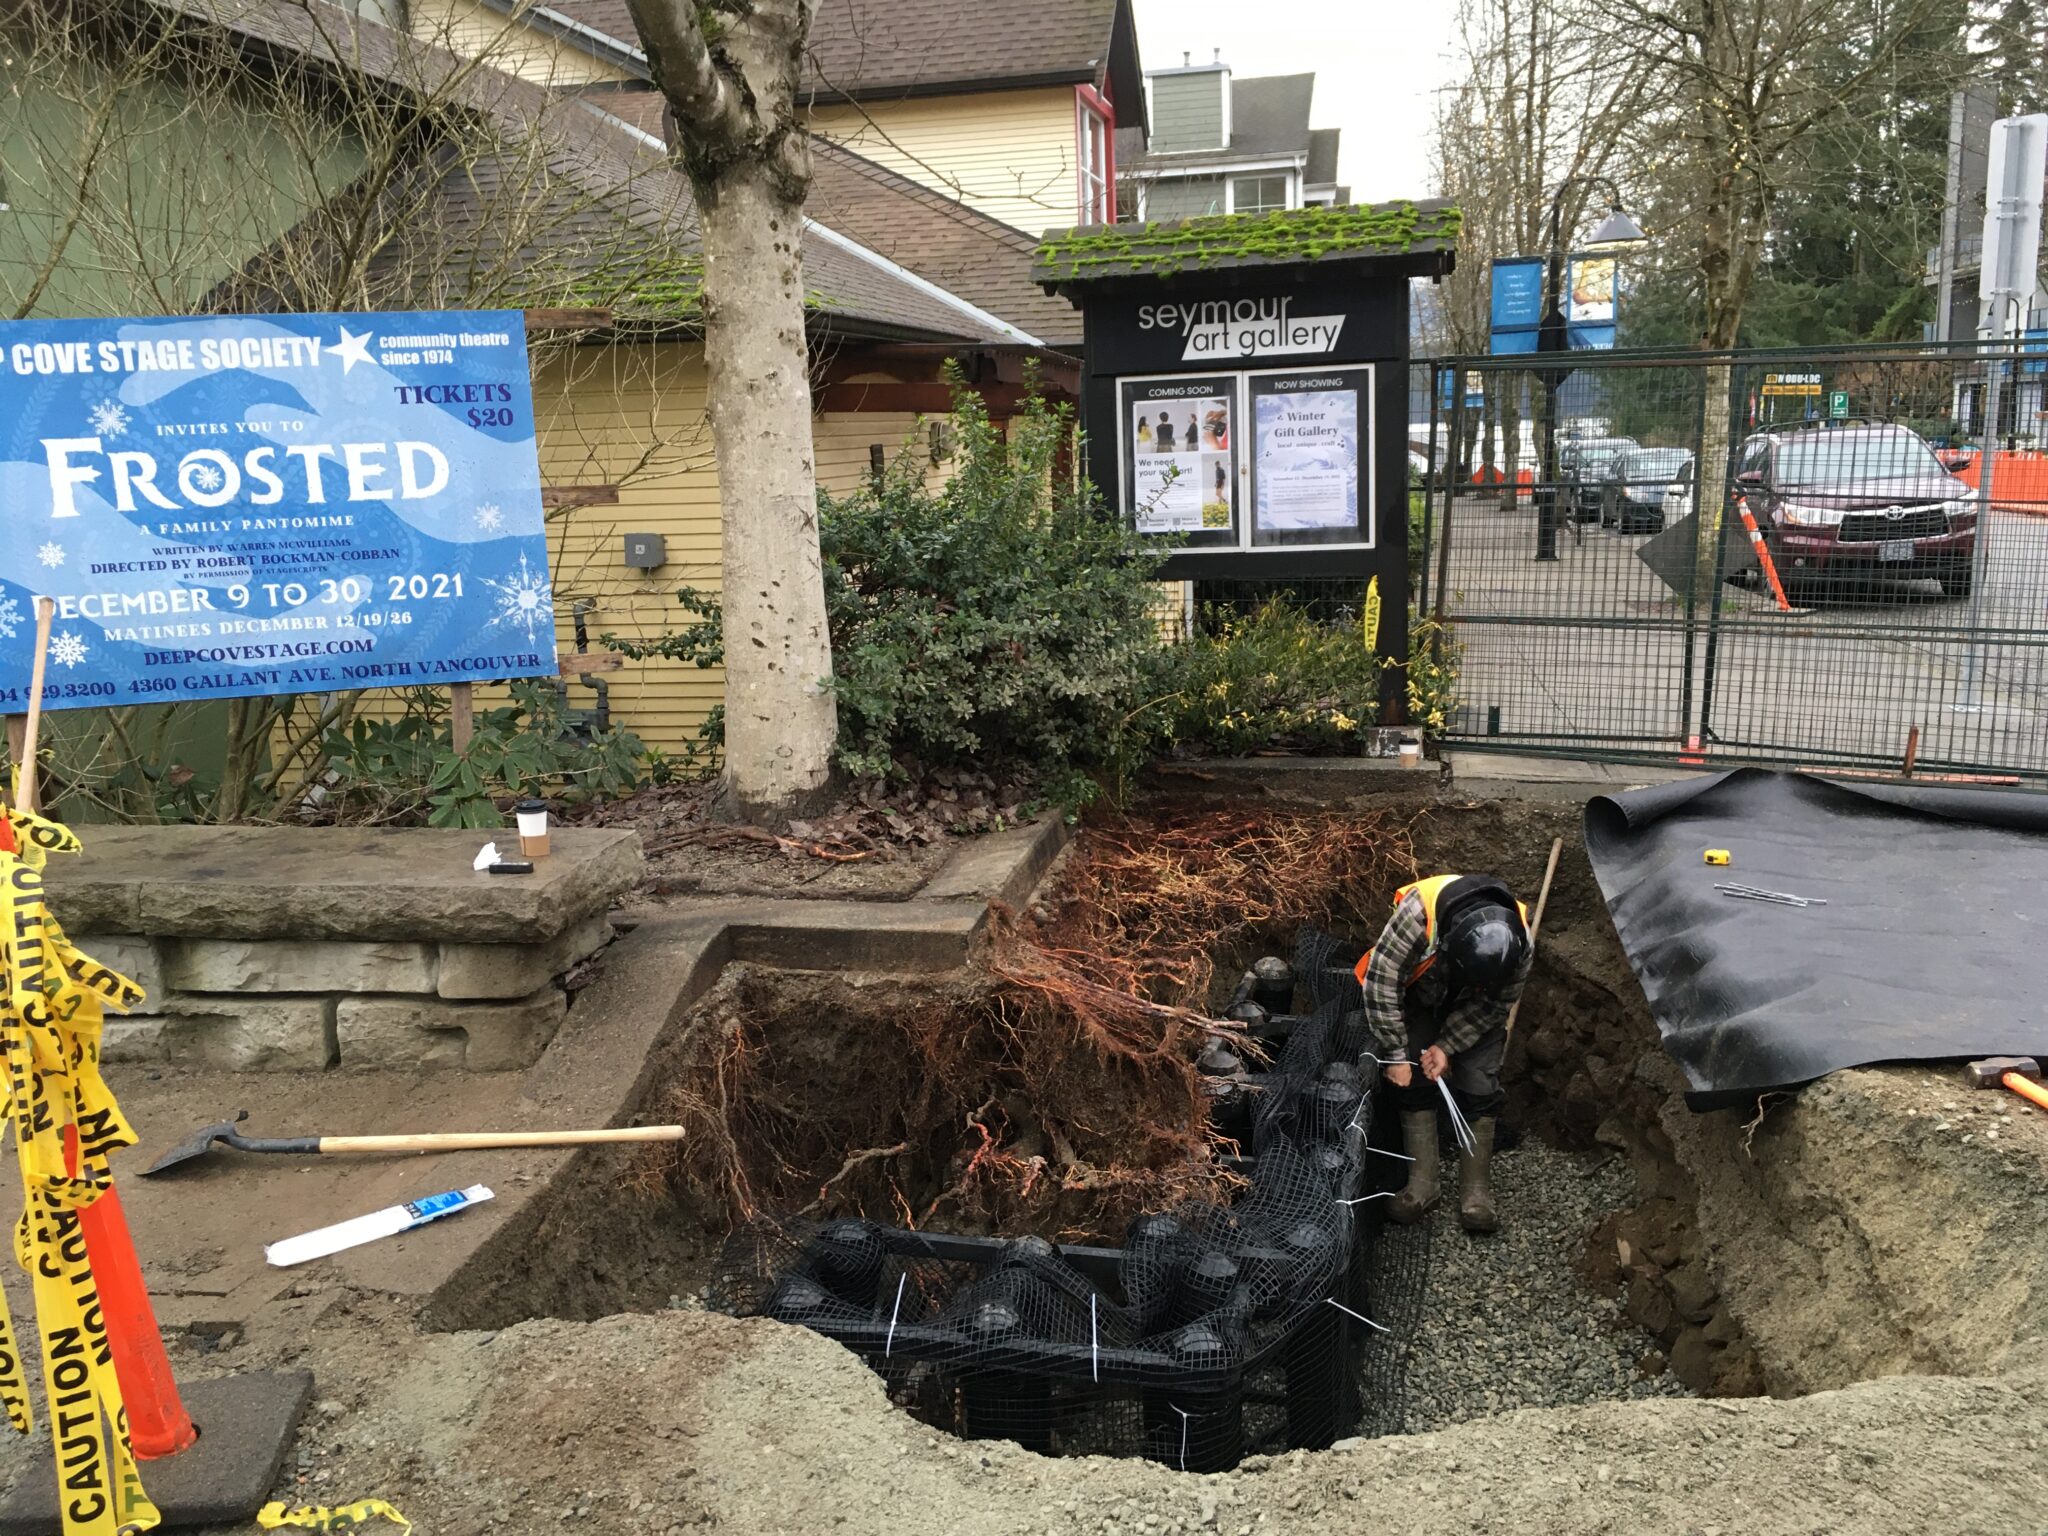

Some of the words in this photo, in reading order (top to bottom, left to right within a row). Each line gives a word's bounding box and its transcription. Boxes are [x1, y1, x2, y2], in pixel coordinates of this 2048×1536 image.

[1138, 296, 1293, 337] seymour
[379, 334, 457, 350] community
[460, 332, 510, 347] theatre
[1193, 321, 1230, 351] art
[1239, 317, 1338, 357] gallery
[12, 342, 93, 375] COVE
[98, 339, 195, 372] STAGE
[200, 336, 321, 370] SOCIETY
[381, 350, 420, 366] since
[422, 349, 453, 364] 1974
[394, 383, 512, 405] TICKETS
[1148, 387, 1186, 397] COMING
[1186, 385, 1214, 395] SOON
[1274, 381, 1298, 390] NOW
[1299, 377, 1343, 389] SHOWING
[1834, 395, 1844, 407] P
[467, 407, 514, 430] $20
[1287, 412, 1326, 421] Winter
[156, 423, 228, 437] INVITES
[237, 421, 273, 434] YOU
[281, 420, 304, 432] TO
[1274, 427, 1295, 438] Gift
[1298, 426, 1339, 438] Gallery
[1138, 459, 1151, 467] We
[1154, 458, 1175, 467] need
[1139, 470, 1156, 478] your
[1158, 467, 1193, 478] suport!
[40, 437, 449, 518] FROSTED
[140, 524, 151, 536] A
[160, 520, 233, 535] FAMILY
[242, 515, 355, 530] PANTOMIME
[152, 545, 206, 556] WRITTEN
[207, 544, 225, 554] BY
[227, 541, 276, 552] WARREN
[278, 538, 352, 550] MCWILLIAMS
[91, 560, 167, 575] DIRECTED
[172, 559, 191, 570] BY
[196, 555, 256, 569] ROBERT
[261, 547, 400, 565] BOCKMAN-COBBAN
[198, 569, 250, 578] PERMISSION
[252, 567, 264, 575] OF
[227, 584, 249, 609] 9
[262, 583, 308, 607] TO
[319, 578, 373, 605] 30,
[388, 572, 464, 601] 2021
[104, 622, 212, 642] MATINEES
[220, 617, 328, 634] DECEMBER
[336, 610, 413, 628] 12/19/26
[144, 639, 374, 667] DEEPCOVESTAGE.COM
[128, 676, 176, 694] 4360
[183, 670, 281, 690] GALLANT
[288, 666, 336, 683] AVE.
[341, 662, 412, 680] NORTH
[416, 653, 541, 673] VANCOUVER
[48, 1326, 107, 1523] CAUTION
